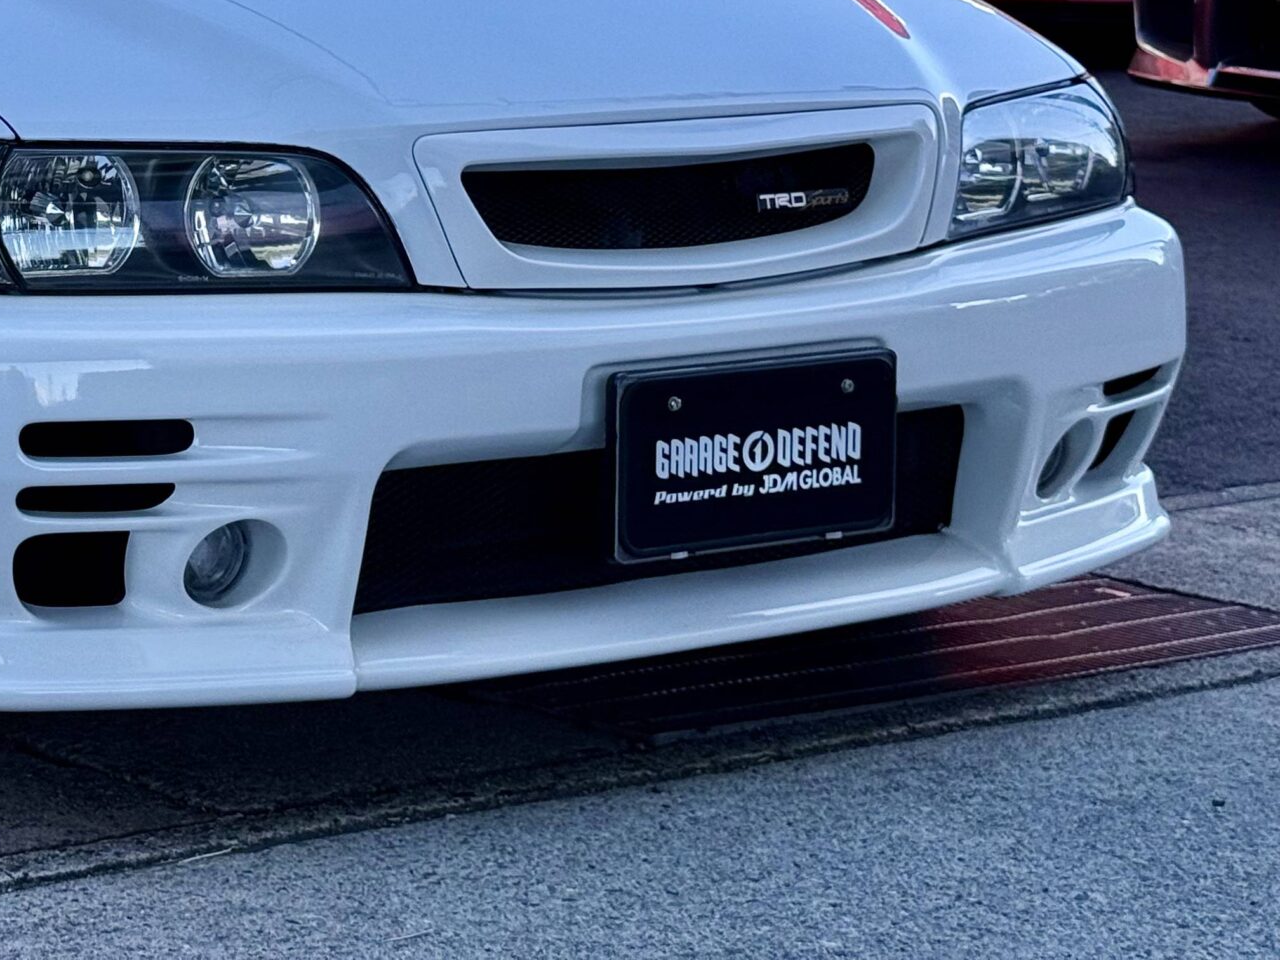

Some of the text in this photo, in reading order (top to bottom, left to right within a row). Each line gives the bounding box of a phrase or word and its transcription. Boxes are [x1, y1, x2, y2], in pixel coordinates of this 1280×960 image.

[759, 191, 807, 210] TRD
[655, 433, 741, 480] GARAGE
[776, 421, 862, 468] DEFEND
[654, 484, 728, 505] Powerd
[731, 482, 756, 497] by
